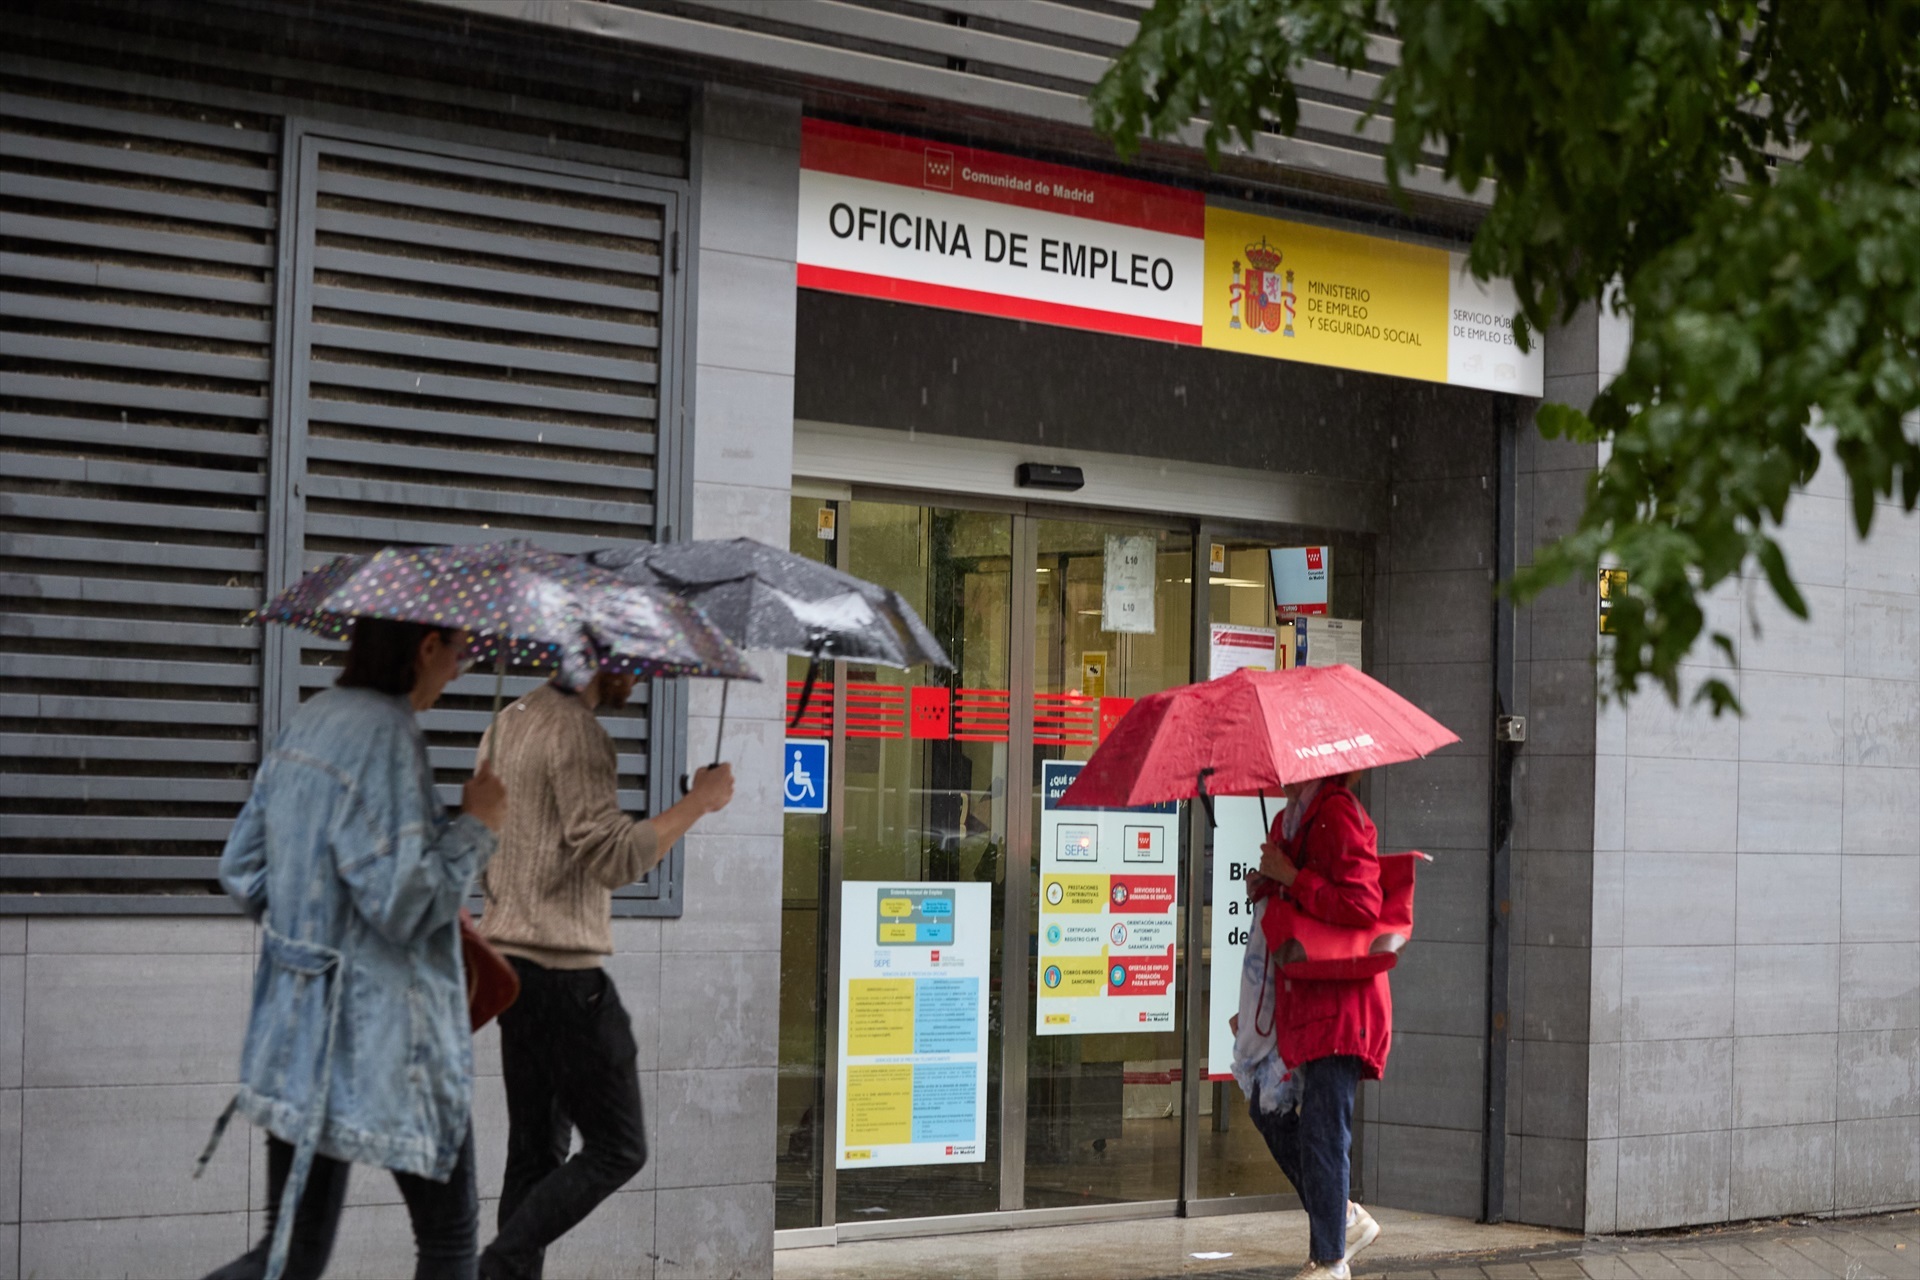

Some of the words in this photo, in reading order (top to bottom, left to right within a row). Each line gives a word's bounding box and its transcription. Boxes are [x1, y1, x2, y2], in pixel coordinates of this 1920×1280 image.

[962, 168, 1032, 192] Comunidad
[1035, 181, 1050, 195] de
[1053, 184, 1094, 203] Madrid
[829, 202, 972, 258] OFICINA
[984, 228, 1028, 268] DE
[1040, 239, 1174, 291] EMPLEO
[1308, 280, 1370, 303] MINISTERIO
[1308, 298, 1323, 313] DE
[1326, 301, 1368, 320] EMPLEO
[1453, 309, 1492, 326] SERVICIO
[1307, 316, 1315, 329] Y
[1318, 317, 1380, 340] SEGURIDAD
[1383, 328, 1422, 346] SOCIAL
[1453, 326, 1465, 338] DE
[1468, 328, 1501, 343] EMPLEO
[1050, 789, 1060, 798] EN
[1065, 844, 1089, 856] SEPE
[1229, 901, 1238, 915] a
